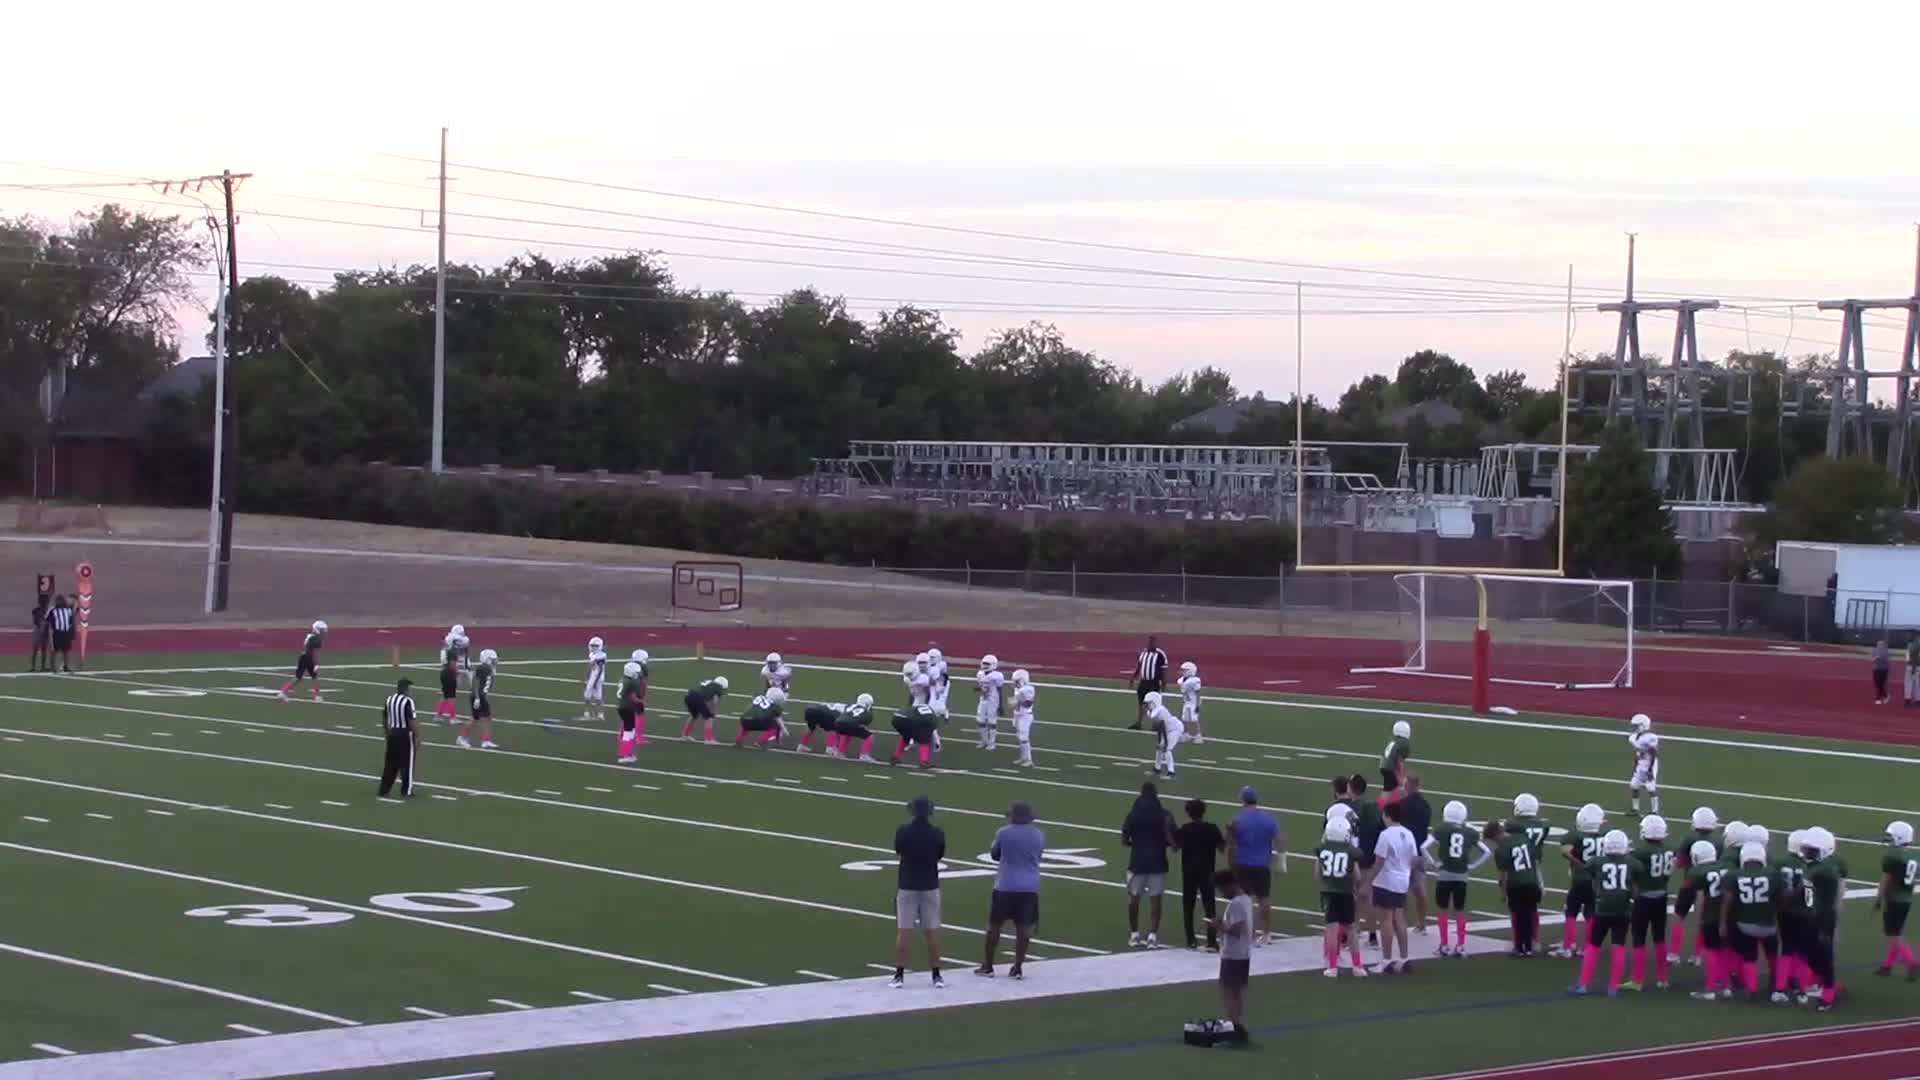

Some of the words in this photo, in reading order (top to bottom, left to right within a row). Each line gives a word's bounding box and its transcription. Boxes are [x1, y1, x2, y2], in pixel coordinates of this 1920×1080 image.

[1450, 833, 1464, 858] 8
[1512, 844, 1532, 872] 21
[1320, 849, 1349, 878] 30
[1602, 863, 1628, 890] 31
[1738, 876, 1769, 904] 52
[184, 892, 515, 926] 30
